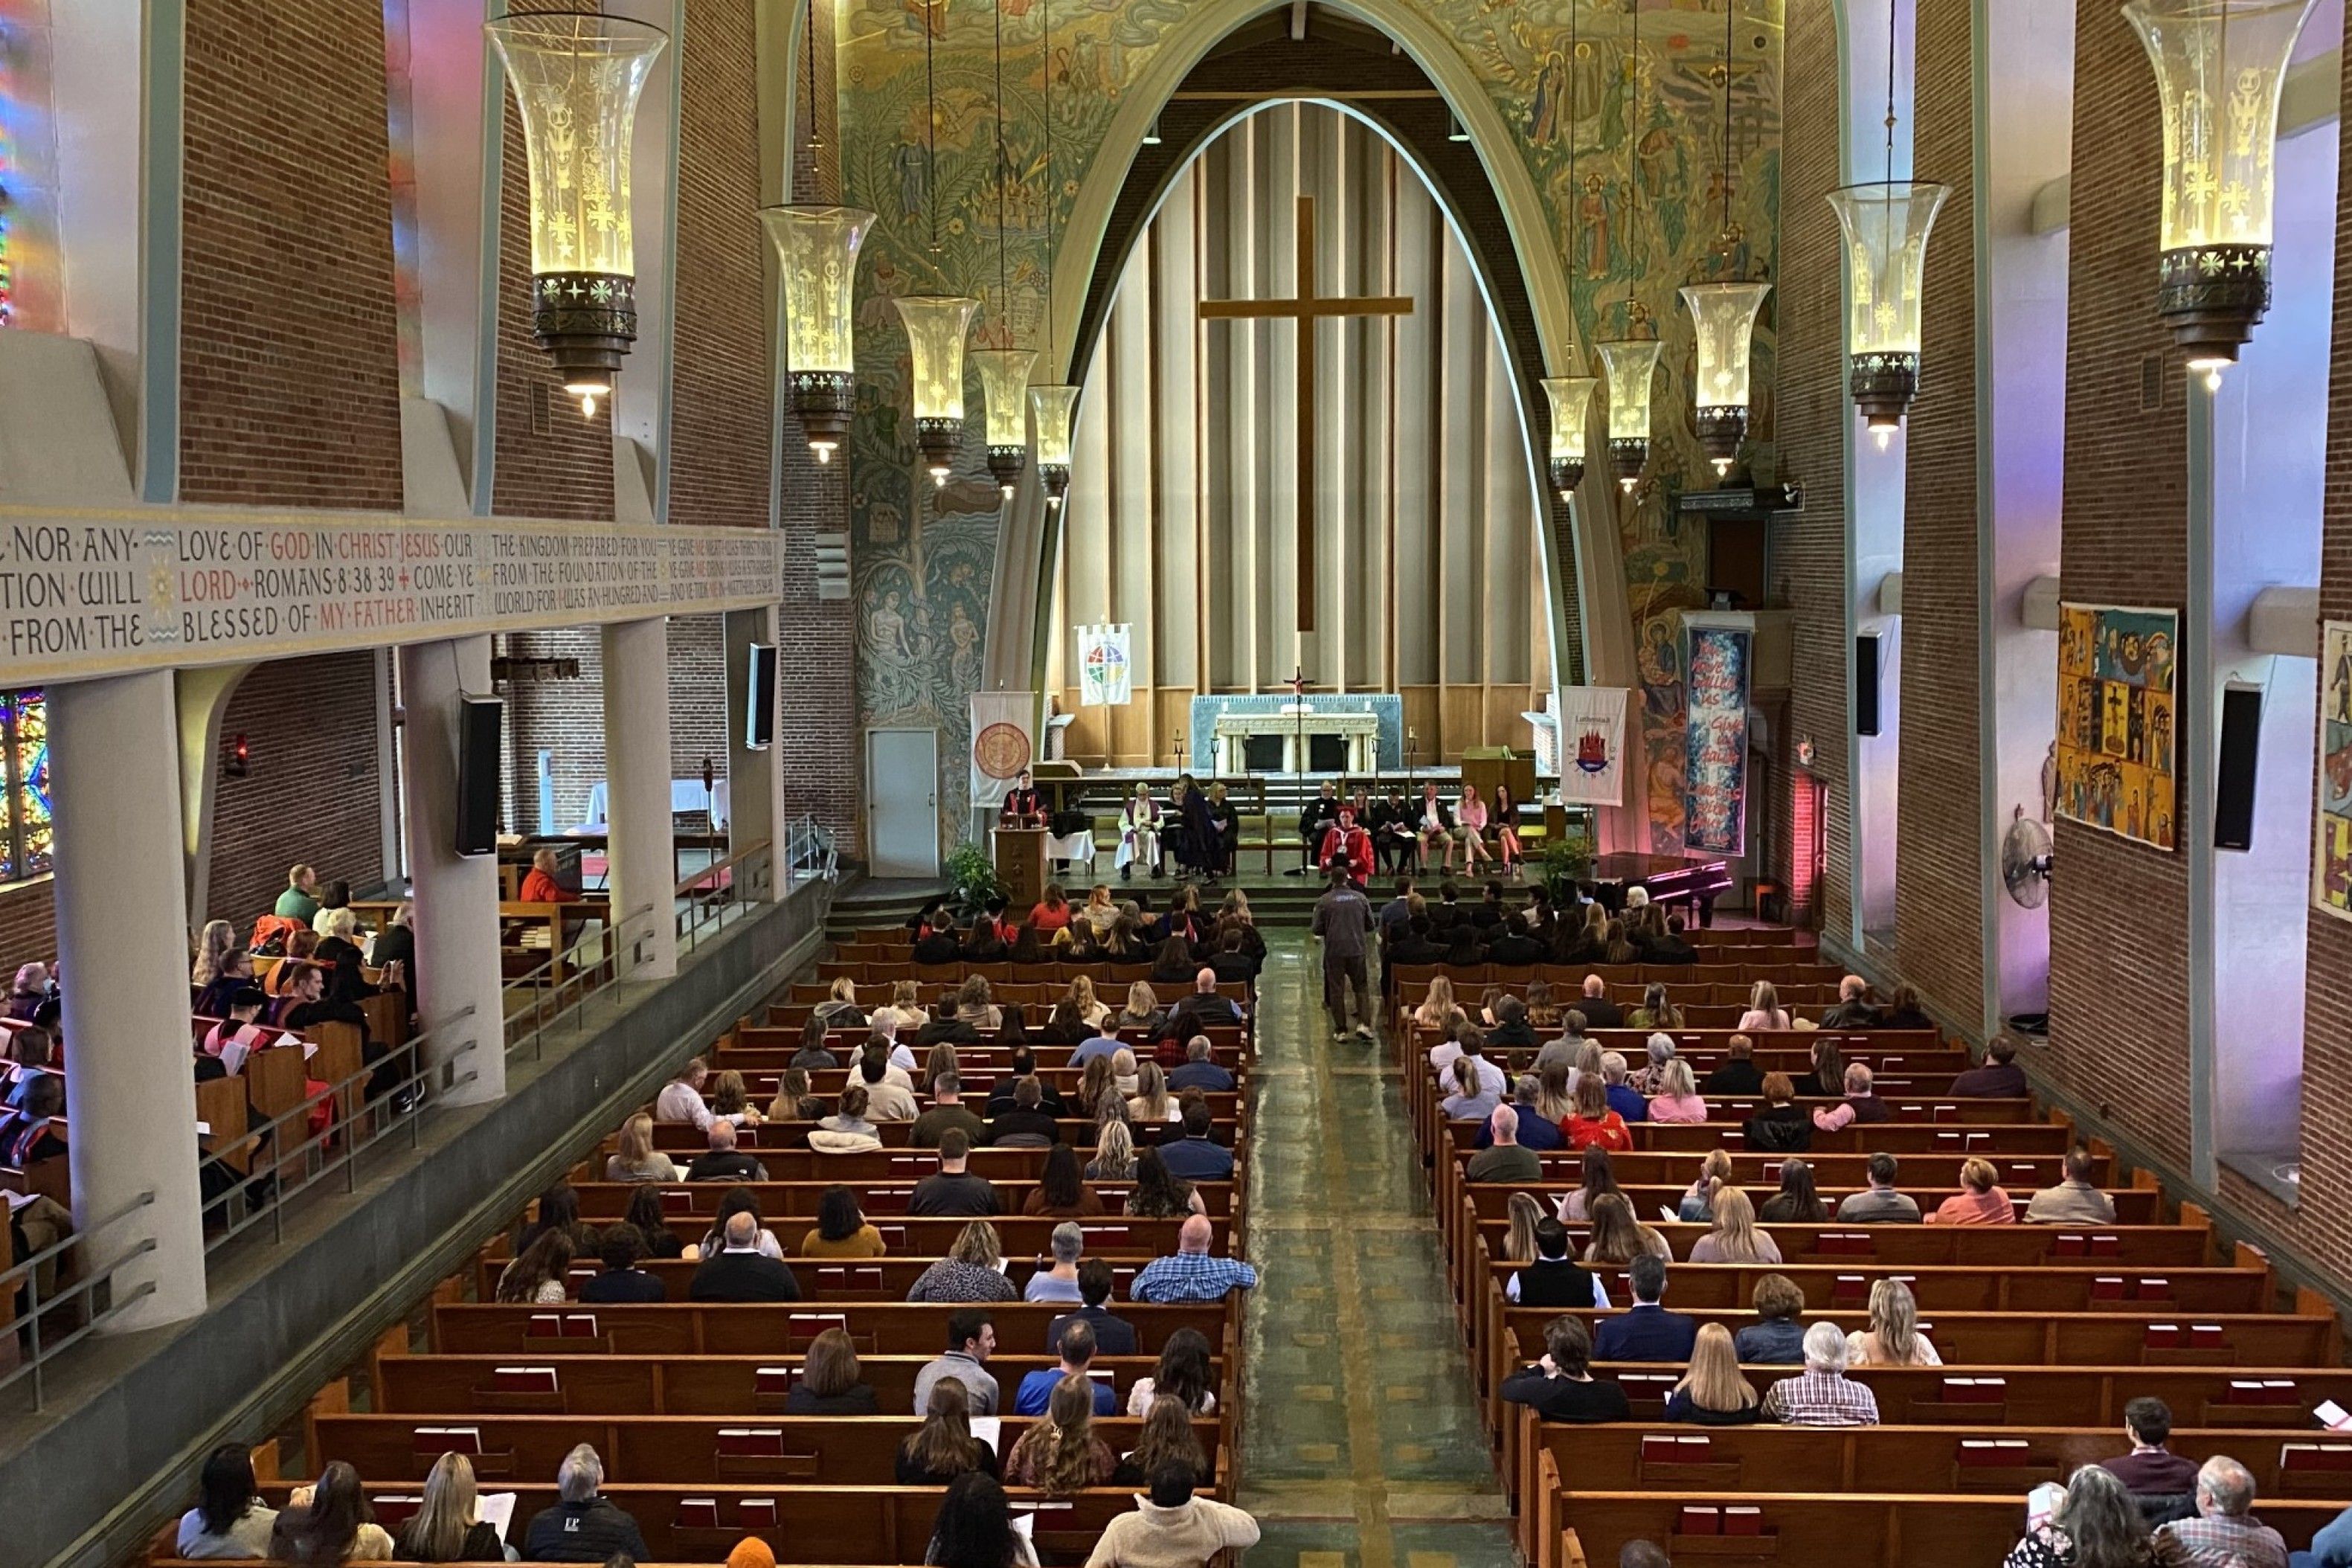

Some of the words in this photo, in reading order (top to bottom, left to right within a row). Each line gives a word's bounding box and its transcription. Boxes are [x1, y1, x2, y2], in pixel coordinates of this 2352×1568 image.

[13, 525, 71, 562] NOR
[83, 527, 135, 561] ANY
[179, 530, 231, 562] LOVE
[238, 531, 263, 560] OF
[271, 532, 310, 560] GOD
[315, 532, 332, 559] IN
[339, 532, 395, 559] CHRIST
[399, 533, 440, 562] JESUS
[446, 533, 472, 558] OUR
[492, 534, 515, 558] THE
[519, 535, 569, 556] KINGDOM
[572, 536, 617, 556] PREPARED
[621, 536, 637, 556] FOR
[640, 537, 657, 556] YOU
[79, 571, 141, 605] WILL
[181, 569, 237, 602] LORD
[254, 567, 332, 598] ROMANS
[414, 565, 454, 590] COME
[458, 564, 474, 588] YE
[492, 562, 527, 585] FROM
[533, 562, 553, 584] THE
[559, 561, 624, 582] FOUNDATION
[628, 561, 637, 580] OF
[640, 561, 657, 580] THE
[495, 591, 534, 614] WORLD
[537, 589, 556, 611] FOR
[565, 588, 585, 609] WAS
[588, 587, 600, 607] AN
[643, 585, 658, 603] AND
[10, 617, 87, 655] FROM
[94, 614, 144, 649] THE
[183, 606, 277, 643] BLESSED
[289, 604, 310, 633] OF
[321, 602, 345, 631] MY
[353, 598, 416, 628] FATHER
[421, 594, 474, 621] INHERIT
